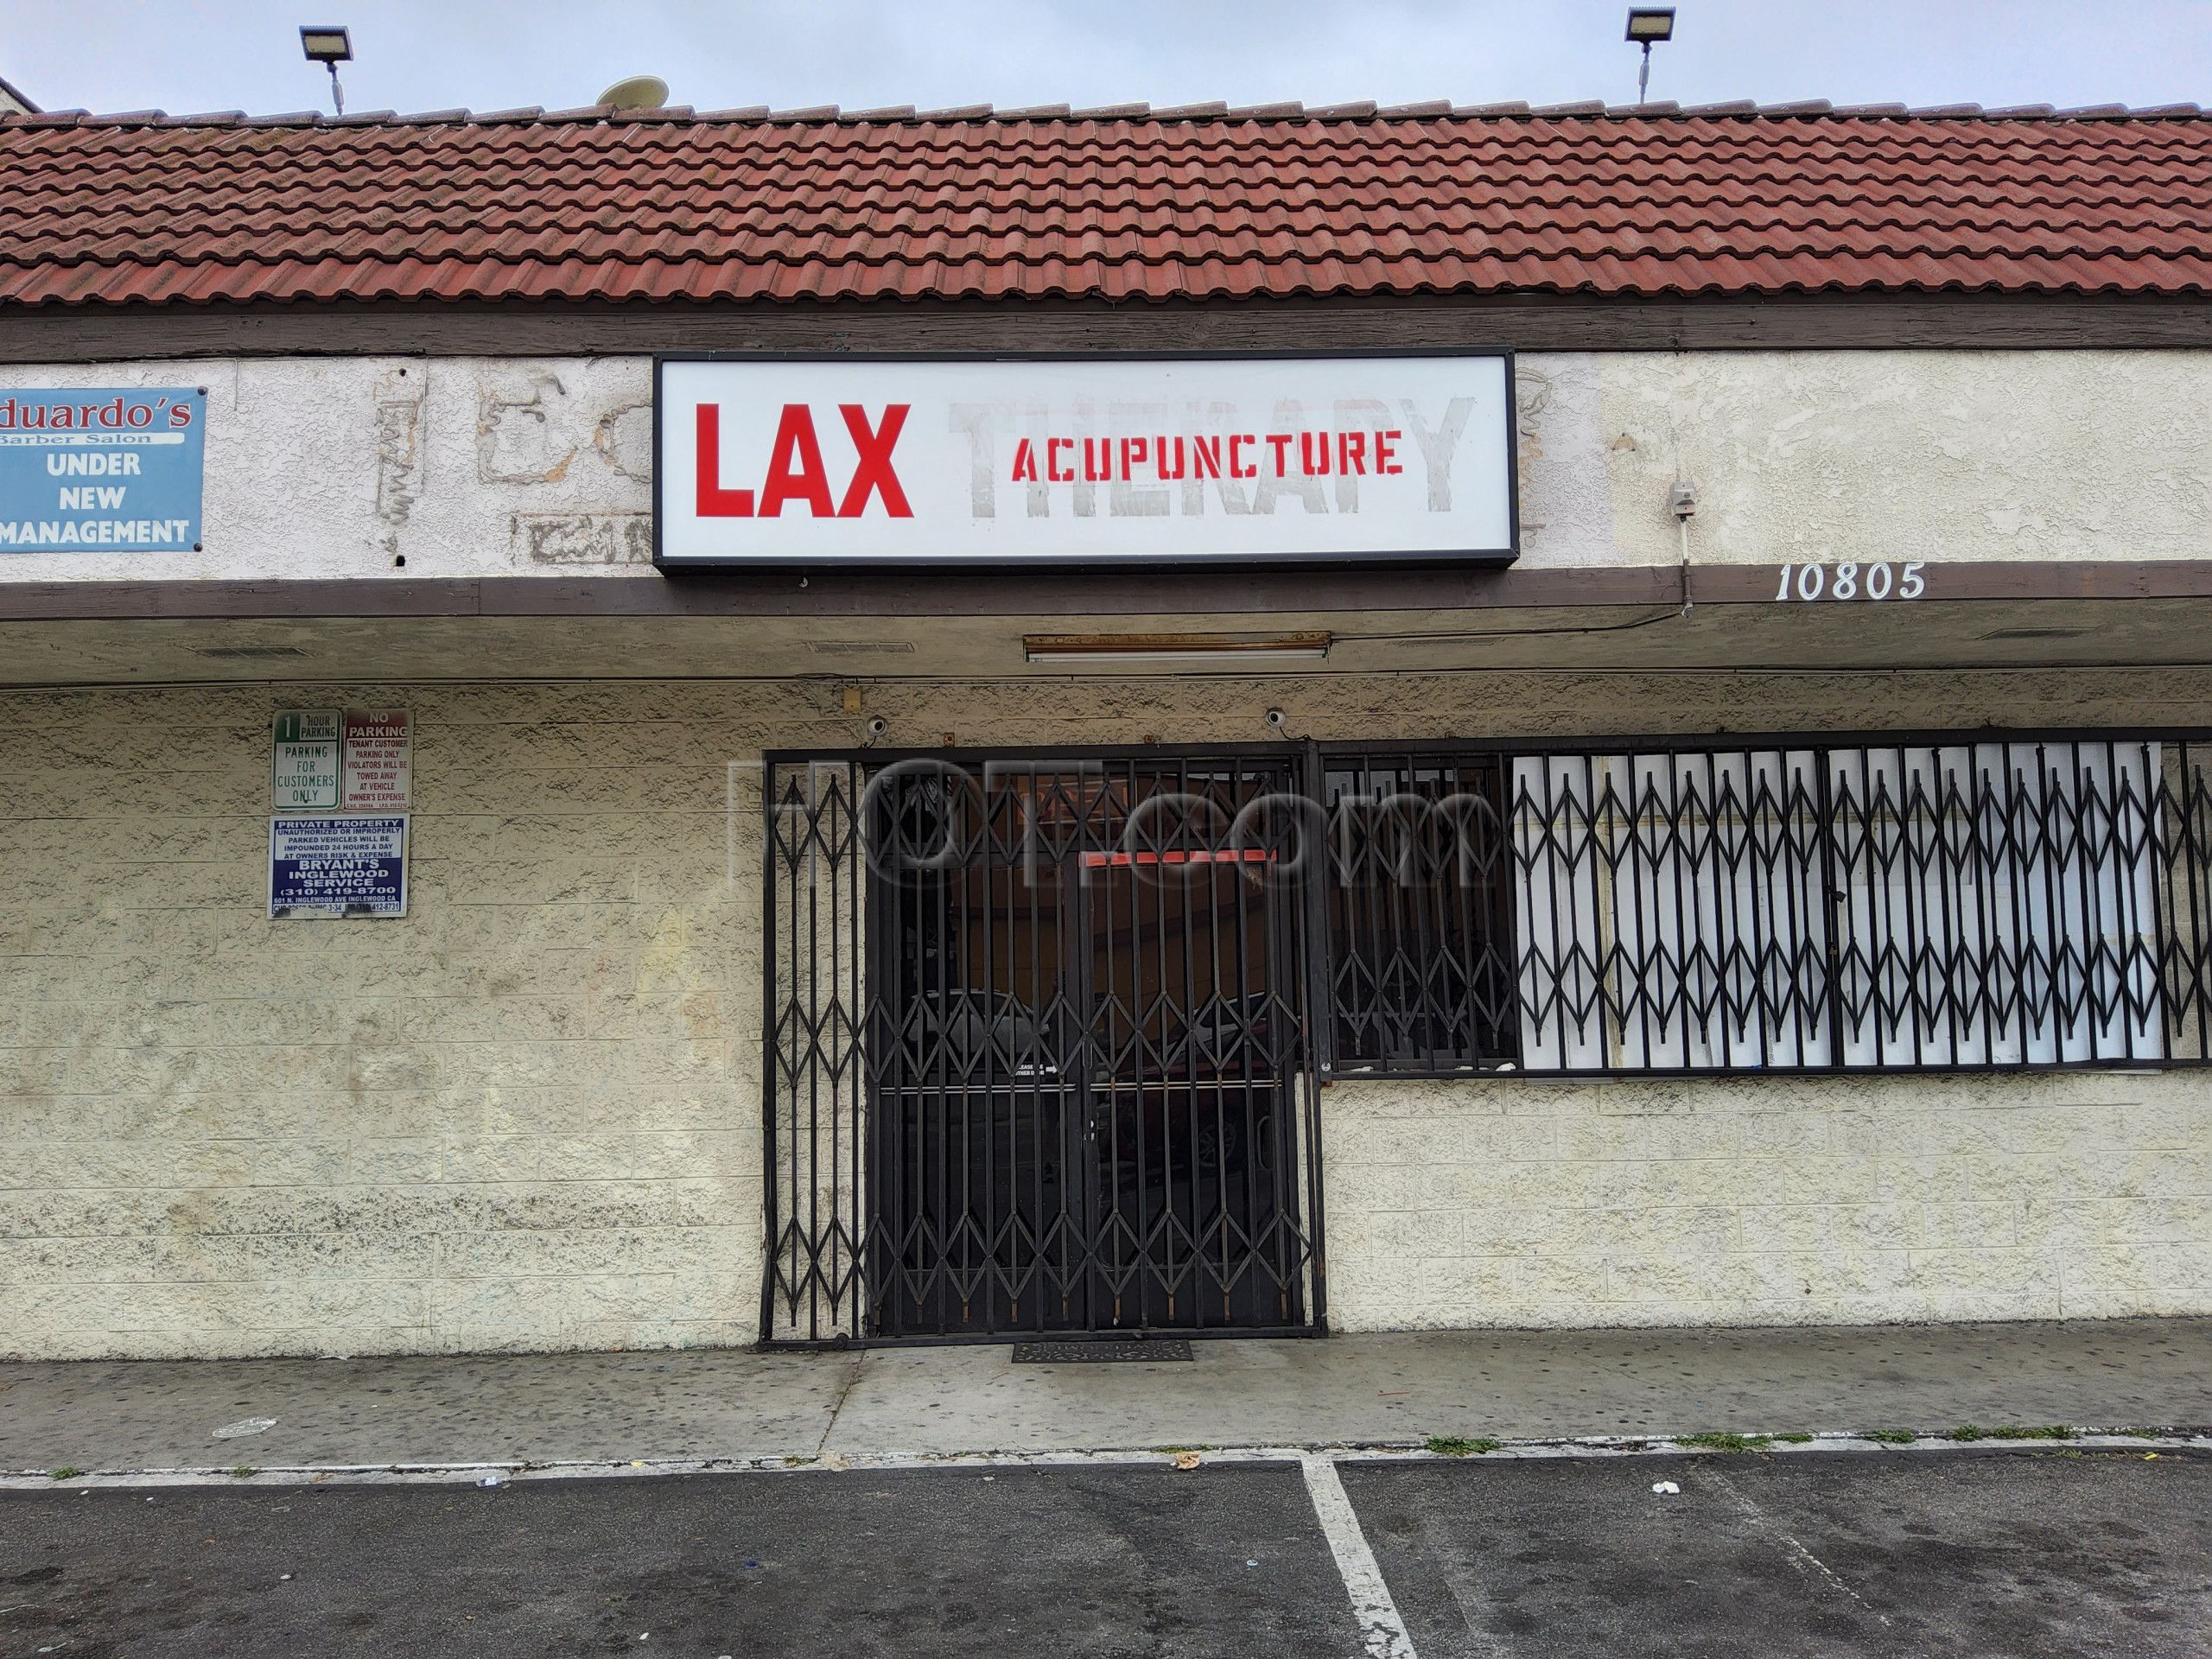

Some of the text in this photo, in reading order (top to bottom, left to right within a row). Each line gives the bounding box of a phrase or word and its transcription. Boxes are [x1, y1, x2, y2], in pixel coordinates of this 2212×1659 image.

[85, 434, 152, 444] Salon
[696, 404, 914, 518] LAX
[1012, 429, 1403, 482] ACUPUNCTURE
[47, 453, 142, 476] UNDER
[59, 486, 127, 510] NEW
[0, 519, 190, 543] MANAGEMENT
[1775, 561, 1925, 601] 10805
[307, 715, 330, 727] HOUR
[369, 712, 389, 723] NO
[284, 715, 291, 738] 1
[349, 726, 409, 737] PARKING
[302, 727, 336, 738] PARKING
[348, 739, 408, 748] TENANT CUSTOMER
[285, 747, 327, 759] PARKING
[355, 750, 383, 759] PARKING
[296, 761, 315, 772] FOR
[347, 760, 408, 769] VIOLATORS WILL BE
[277, 774, 334, 787] CUSTOMERS
[357, 772, 378, 780] TOWED
[359, 782, 368, 791] AT
[292, 790, 319, 803] ONLY
[377, 792, 406, 801] EXPENSE
[299, 859, 379, 871] BRYANT'S
[289, 869, 389, 880] INGLEWOOD
[302, 879, 374, 887] SERVICE
[280, 887, 396, 896] (310) 419-8700
